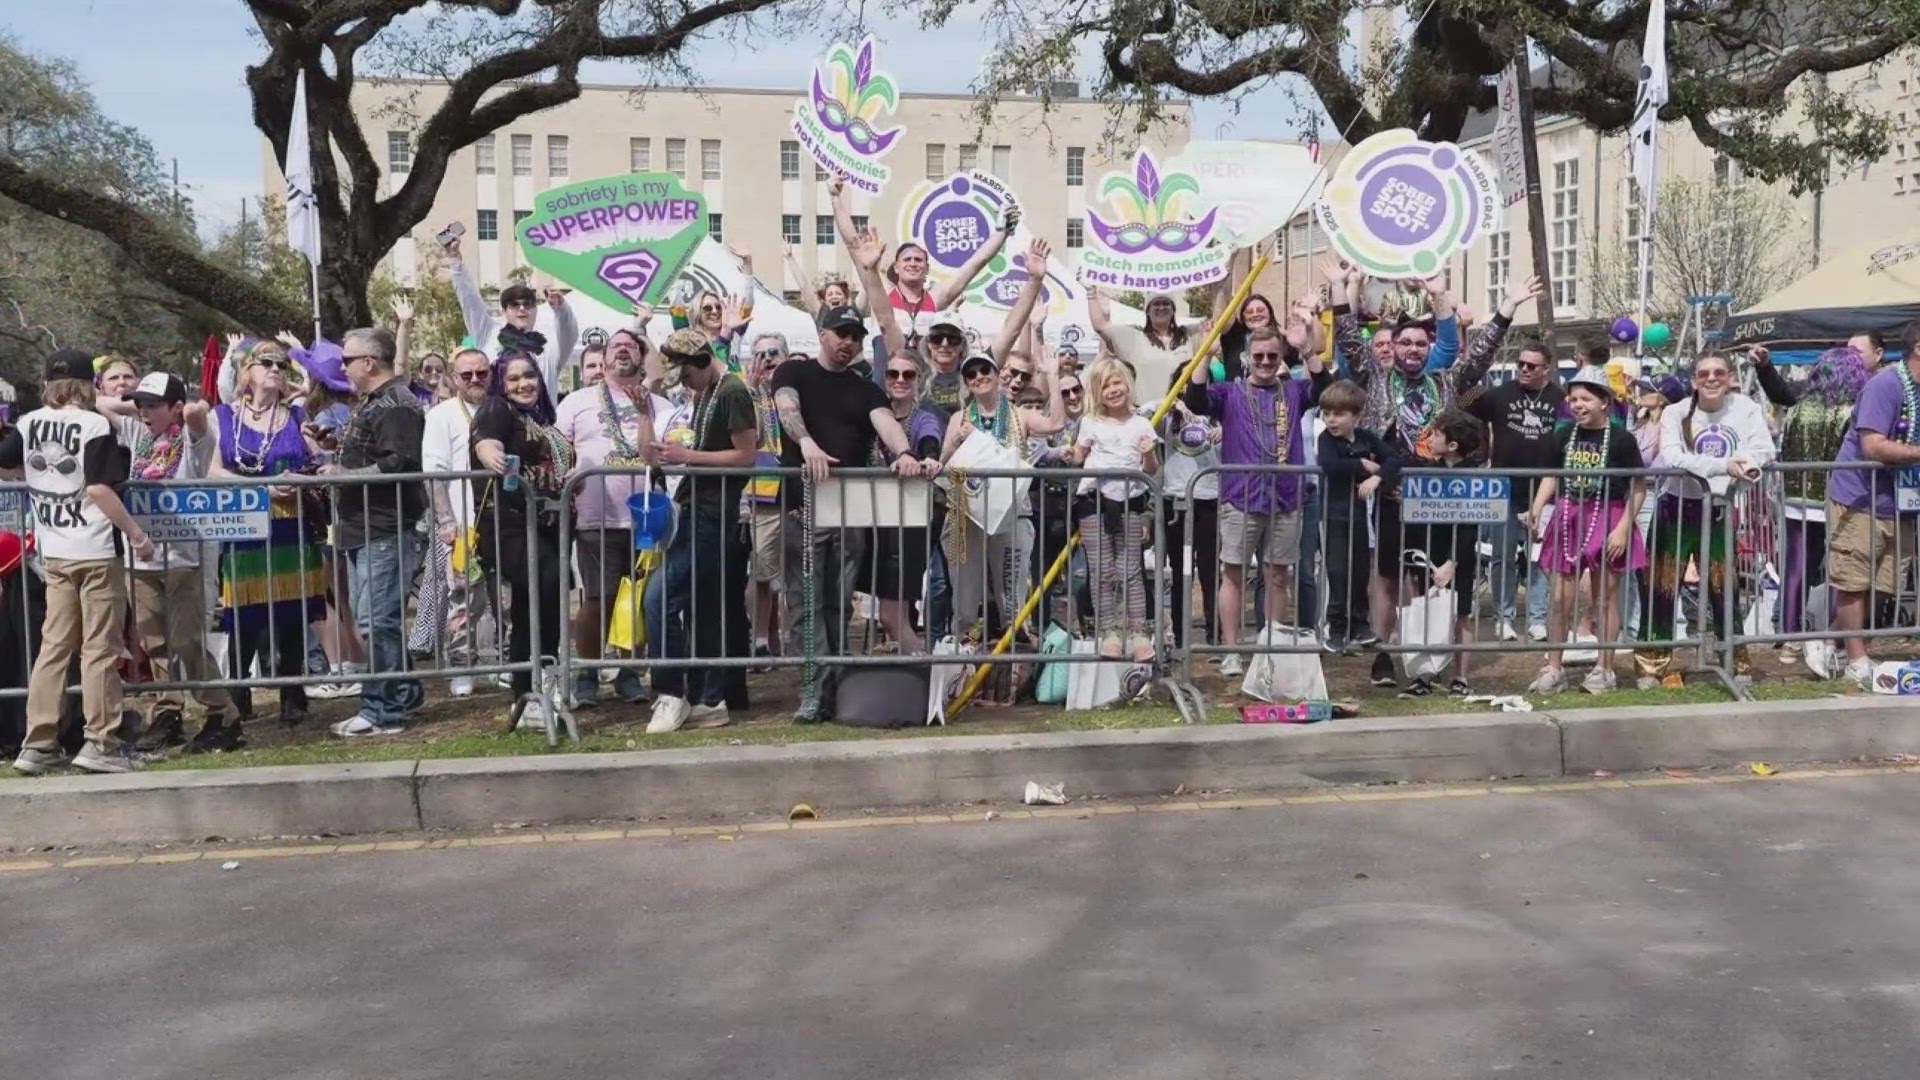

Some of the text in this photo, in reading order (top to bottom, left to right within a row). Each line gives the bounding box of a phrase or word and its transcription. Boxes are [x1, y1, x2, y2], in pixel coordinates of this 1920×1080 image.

[795, 121, 813, 148] not
[799, 105, 887, 179] Catch memories
[974, 172, 1005, 194] MARDI
[1388, 176, 1436, 206] SOBER
[1464, 155, 1493, 230] MARDI GRAS
[546, 180, 670, 213] sobriety is my
[1378, 188, 1432, 221] SAFE
[525, 199, 699, 247] SUPERPOWER
[935, 216, 977, 229] SOBER
[1321, 204, 1340, 231] 2025
[935, 226, 978, 241] SAFE
[1084, 249, 1225, 272] Catch memories
[1086, 266, 1221, 290] not hangovers
[28, 419, 81, 455] KING
[1412, 511, 1499, 519] DO NOT CROSS
[1420, 501, 1491, 509] POLICE LINE
[151, 515, 246, 526] POLICE LINE
[168, 528, 198, 538] NOT
[205, 526, 257, 537] CROSS
